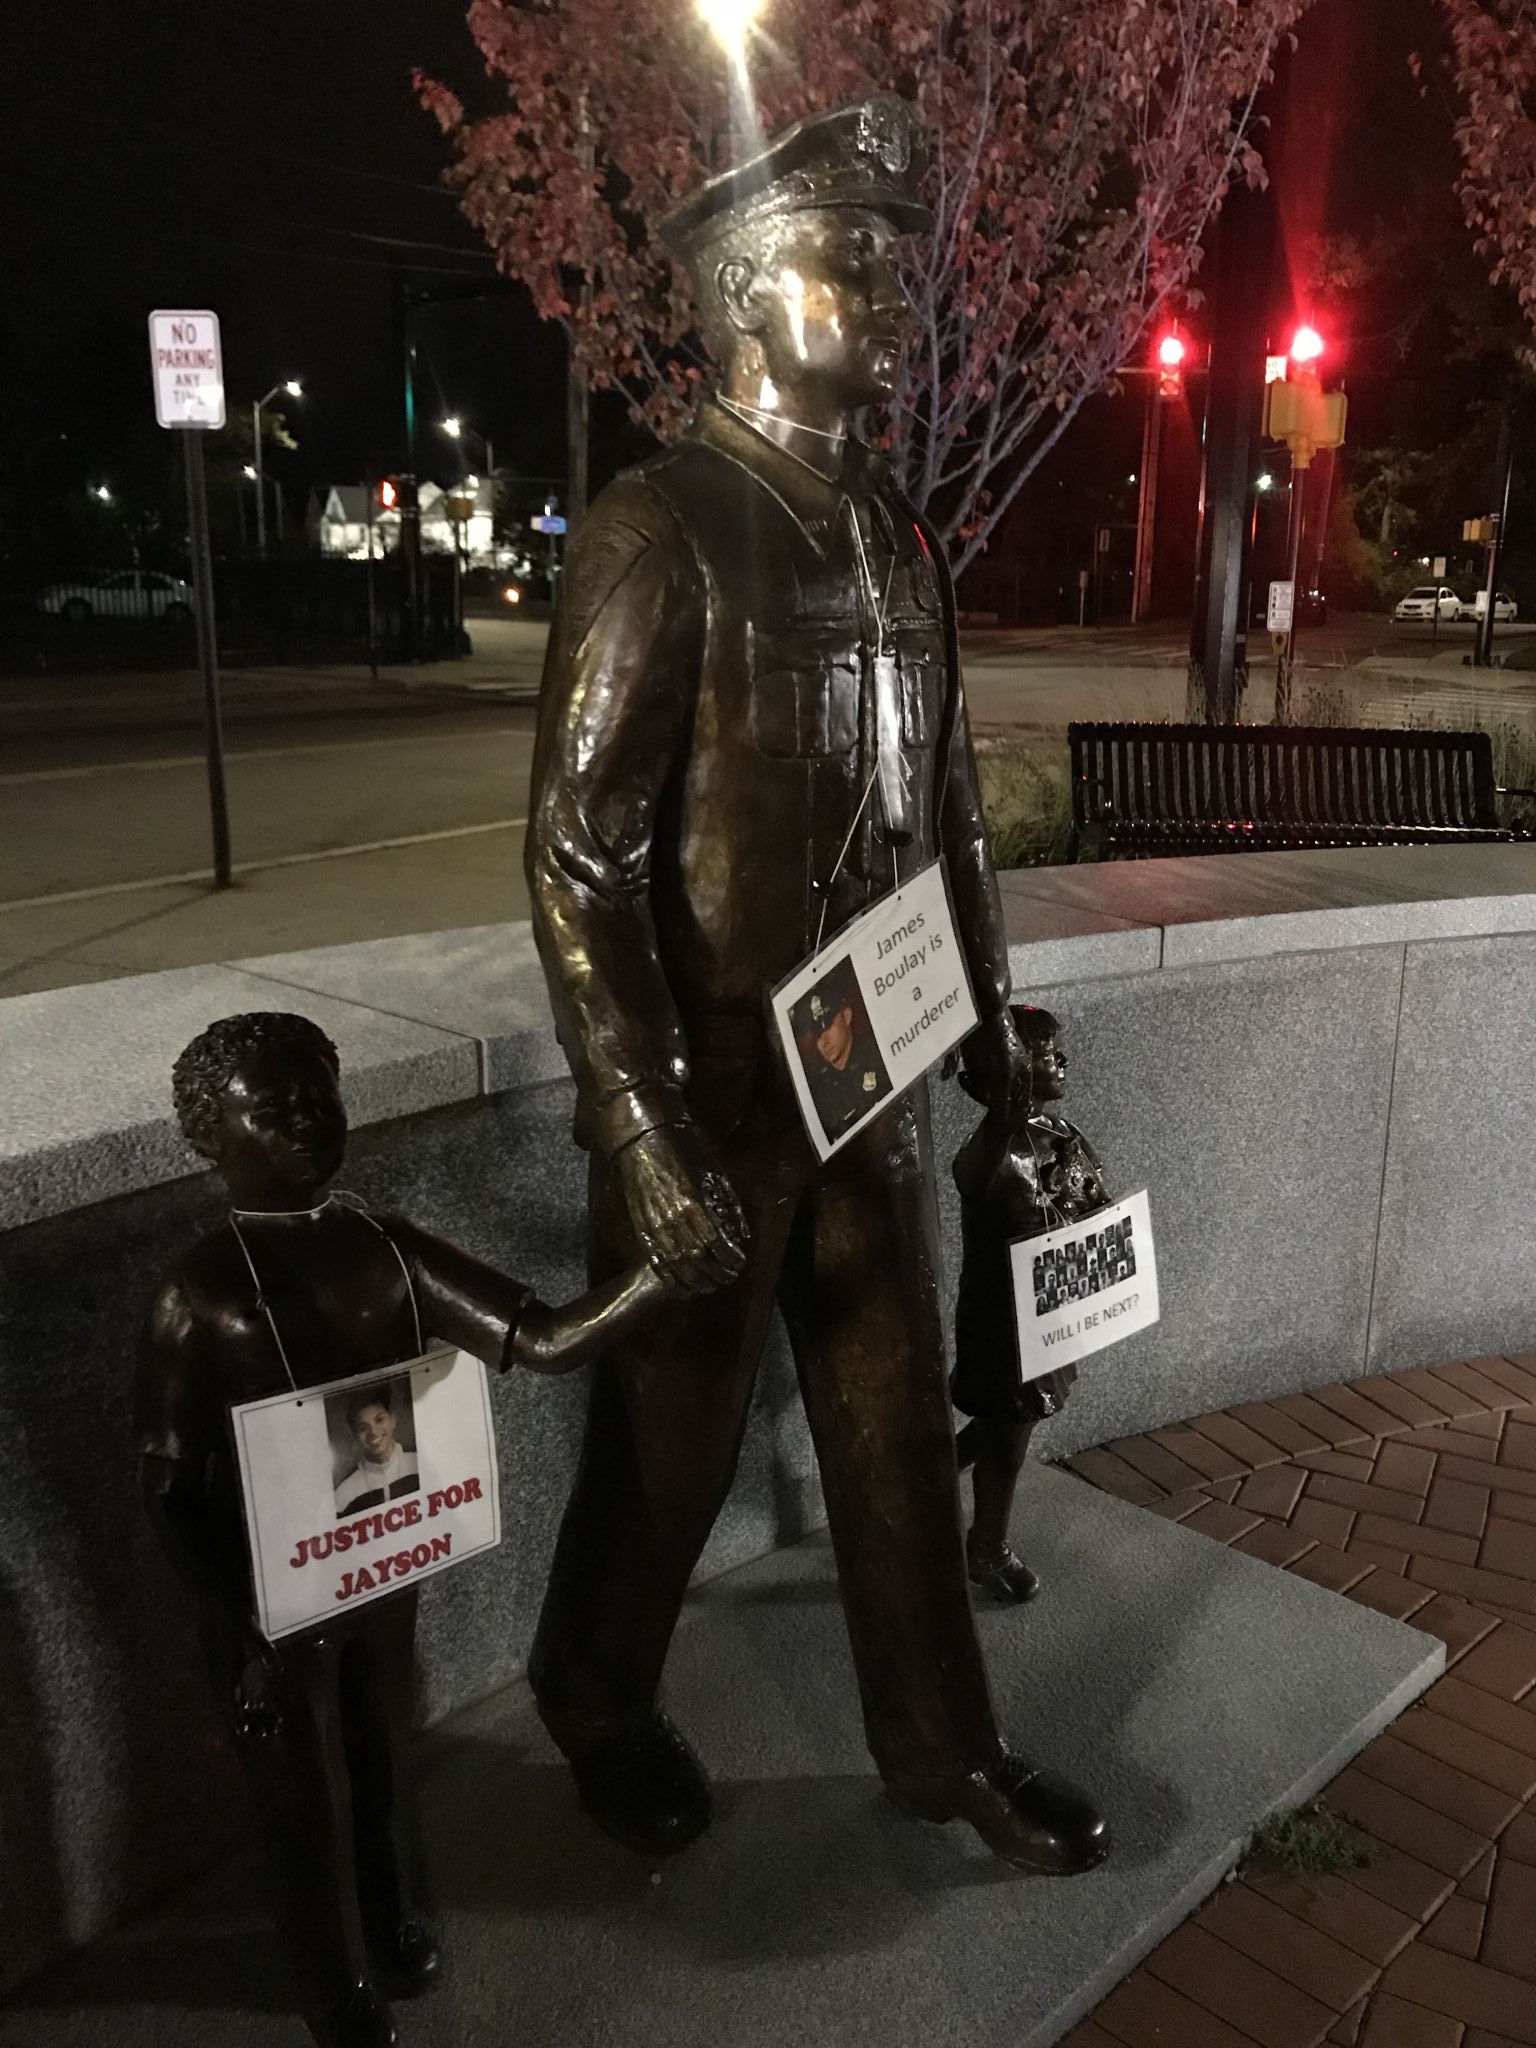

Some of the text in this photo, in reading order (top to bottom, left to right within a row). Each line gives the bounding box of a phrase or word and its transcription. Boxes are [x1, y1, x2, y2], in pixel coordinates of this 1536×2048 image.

[158, 348, 217, 369] PARKING
[171, 323, 197, 344] NO
[175, 373, 200, 387] ANY
[876, 911, 926, 960] James
[873, 932, 942, 997] Boulay is
[912, 985, 923, 1001] a
[889, 987, 961, 1056] murderer
[1042, 1324, 1074, 1347] WILL
[1084, 1312, 1100, 1331] BE
[1103, 1292, 1140, 1322] NEXT?
[289, 1477, 483, 1569] JUSTICE FOR
[335, 1532, 452, 1601] JAYSON
